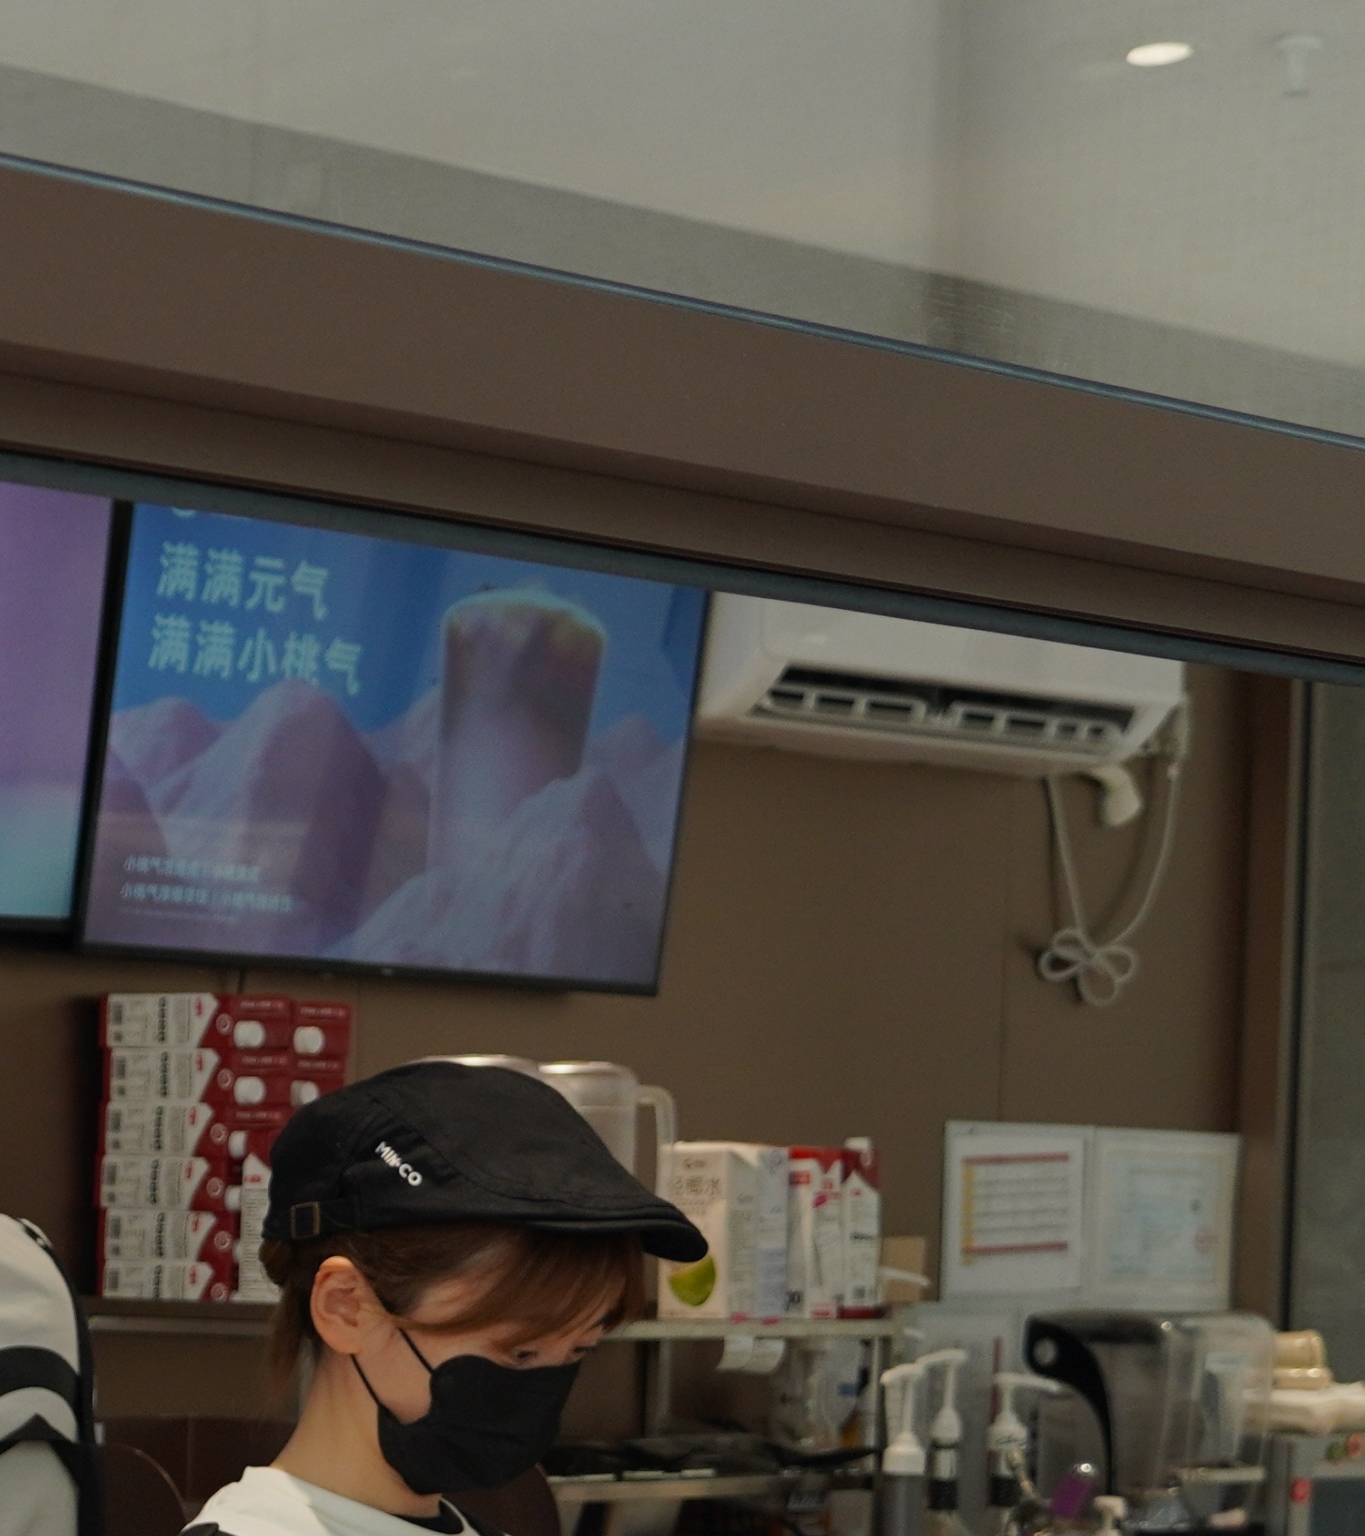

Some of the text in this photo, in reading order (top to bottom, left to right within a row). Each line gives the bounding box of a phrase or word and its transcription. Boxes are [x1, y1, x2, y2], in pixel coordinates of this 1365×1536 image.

[156, 540, 331, 620] 满满元气
[147, 612, 365, 695] 满满小桃气
